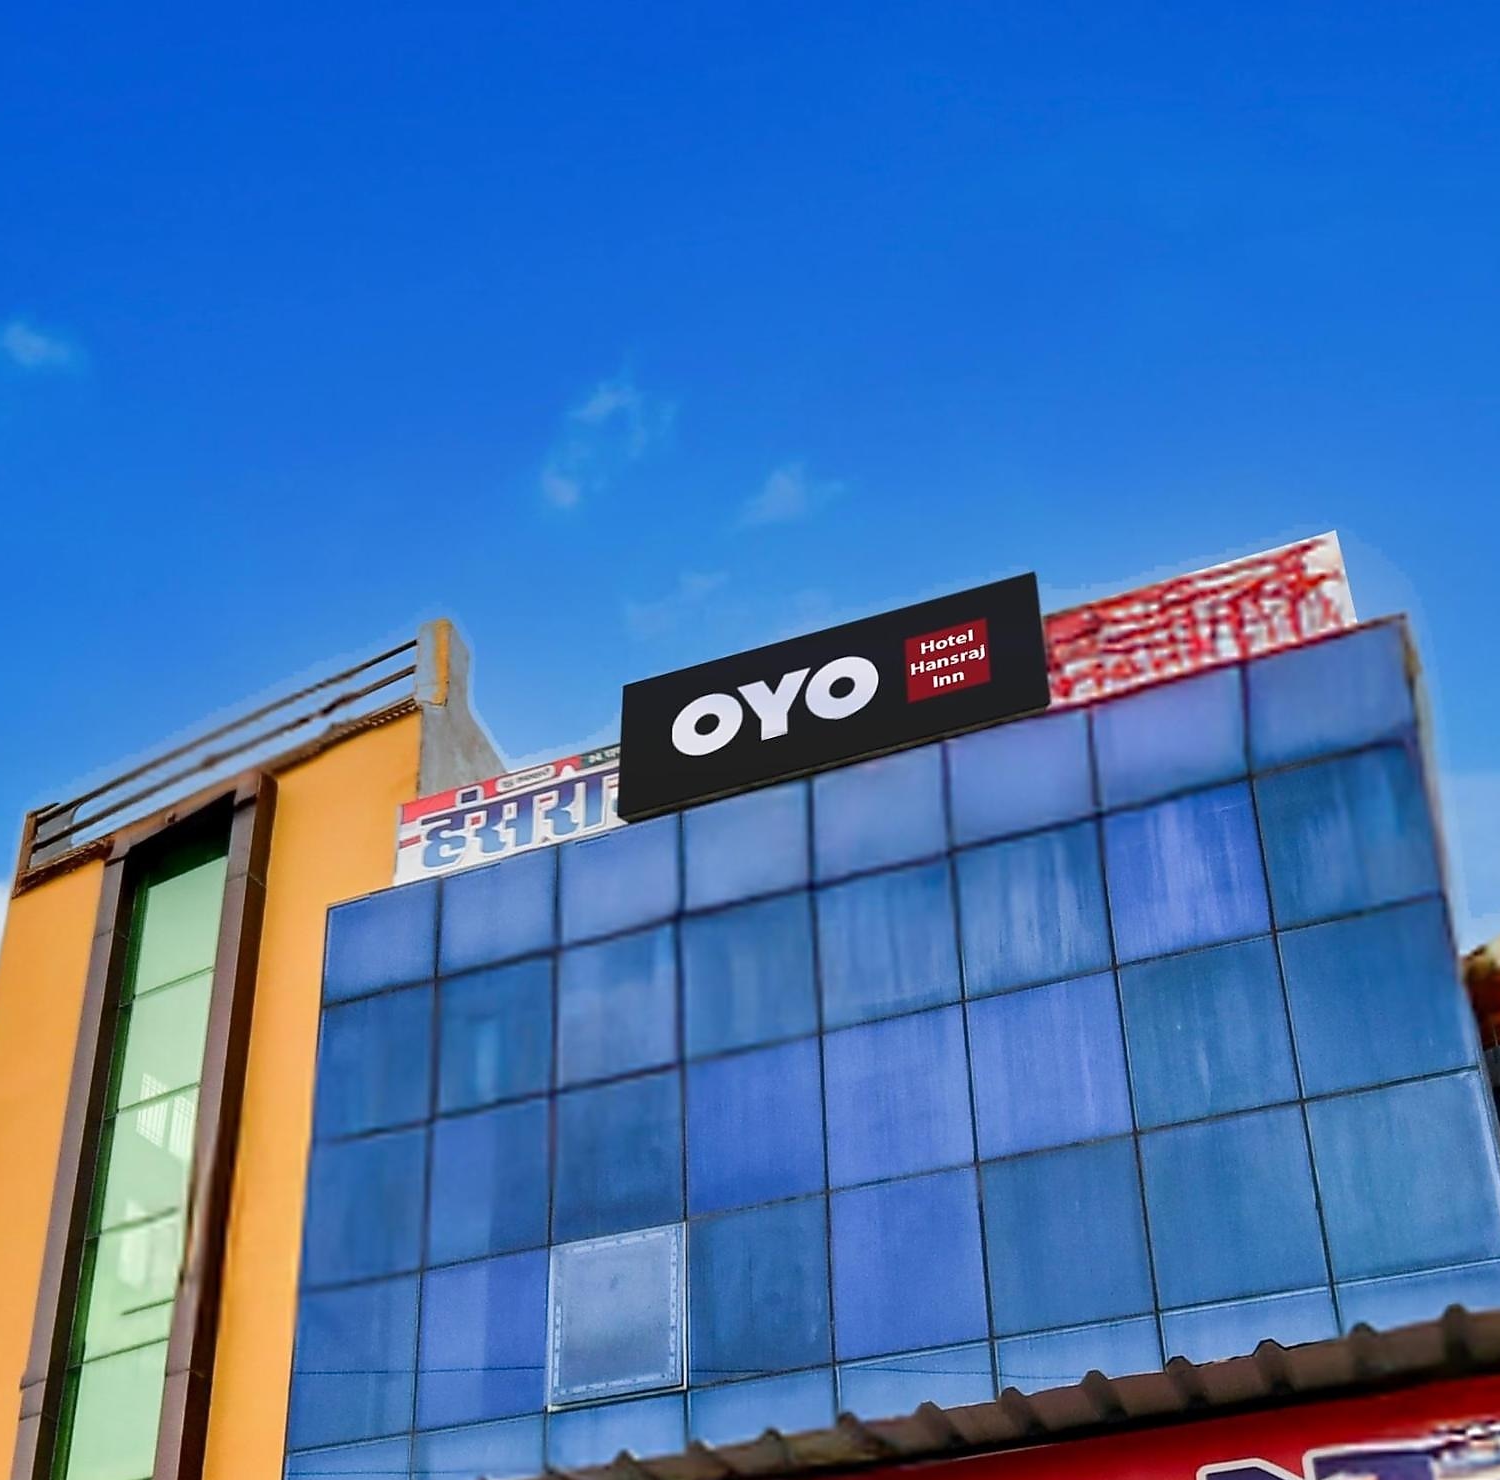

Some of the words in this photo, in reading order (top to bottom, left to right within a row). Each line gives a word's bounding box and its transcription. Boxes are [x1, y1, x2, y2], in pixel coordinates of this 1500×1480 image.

[920, 628, 974, 655] Hotel
[910, 644, 986, 676] Hansraj
[932, 671, 965, 688] Inn
[671, 655, 879, 757] OYO
